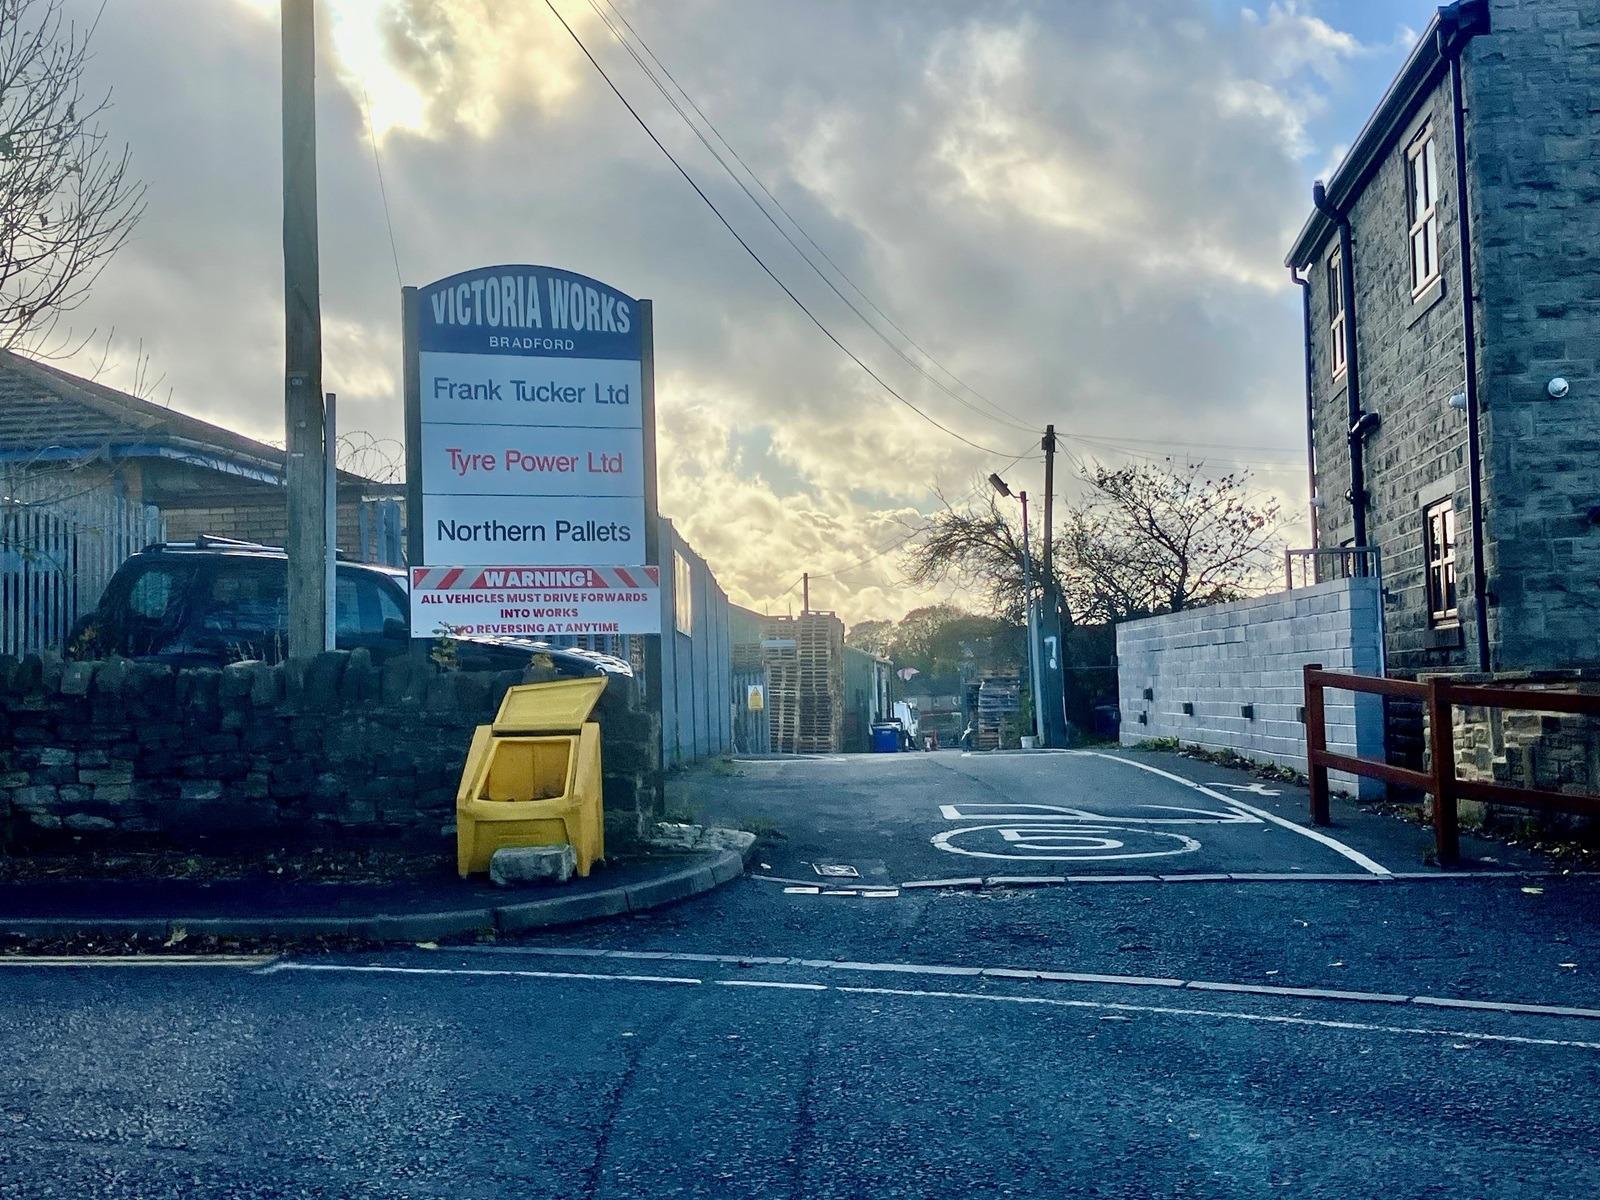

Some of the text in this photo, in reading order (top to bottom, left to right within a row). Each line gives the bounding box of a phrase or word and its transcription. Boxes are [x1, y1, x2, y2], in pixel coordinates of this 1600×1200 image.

[431, 275, 631, 334] VICTORIA WORKS
[489, 336, 575, 351] BRADFORD
[433, 377, 630, 405] Frank Tucker Ltd
[445, 448, 623, 476] Tyre Power Ltd
[437, 519, 631, 542] Northern Pallets
[483, 568, 593, 588] WARNING!
[421, 592, 648, 604] ALL VEHICLES MUST DRIVE FORWARDS
[500, 608, 579, 618] INTO WORKS
[477, 624, 545, 634] REVERSING
[547, 623, 565, 633] AT
[565, 622, 619, 632] ANYTIME
[998, 829, 1123, 850] 5
